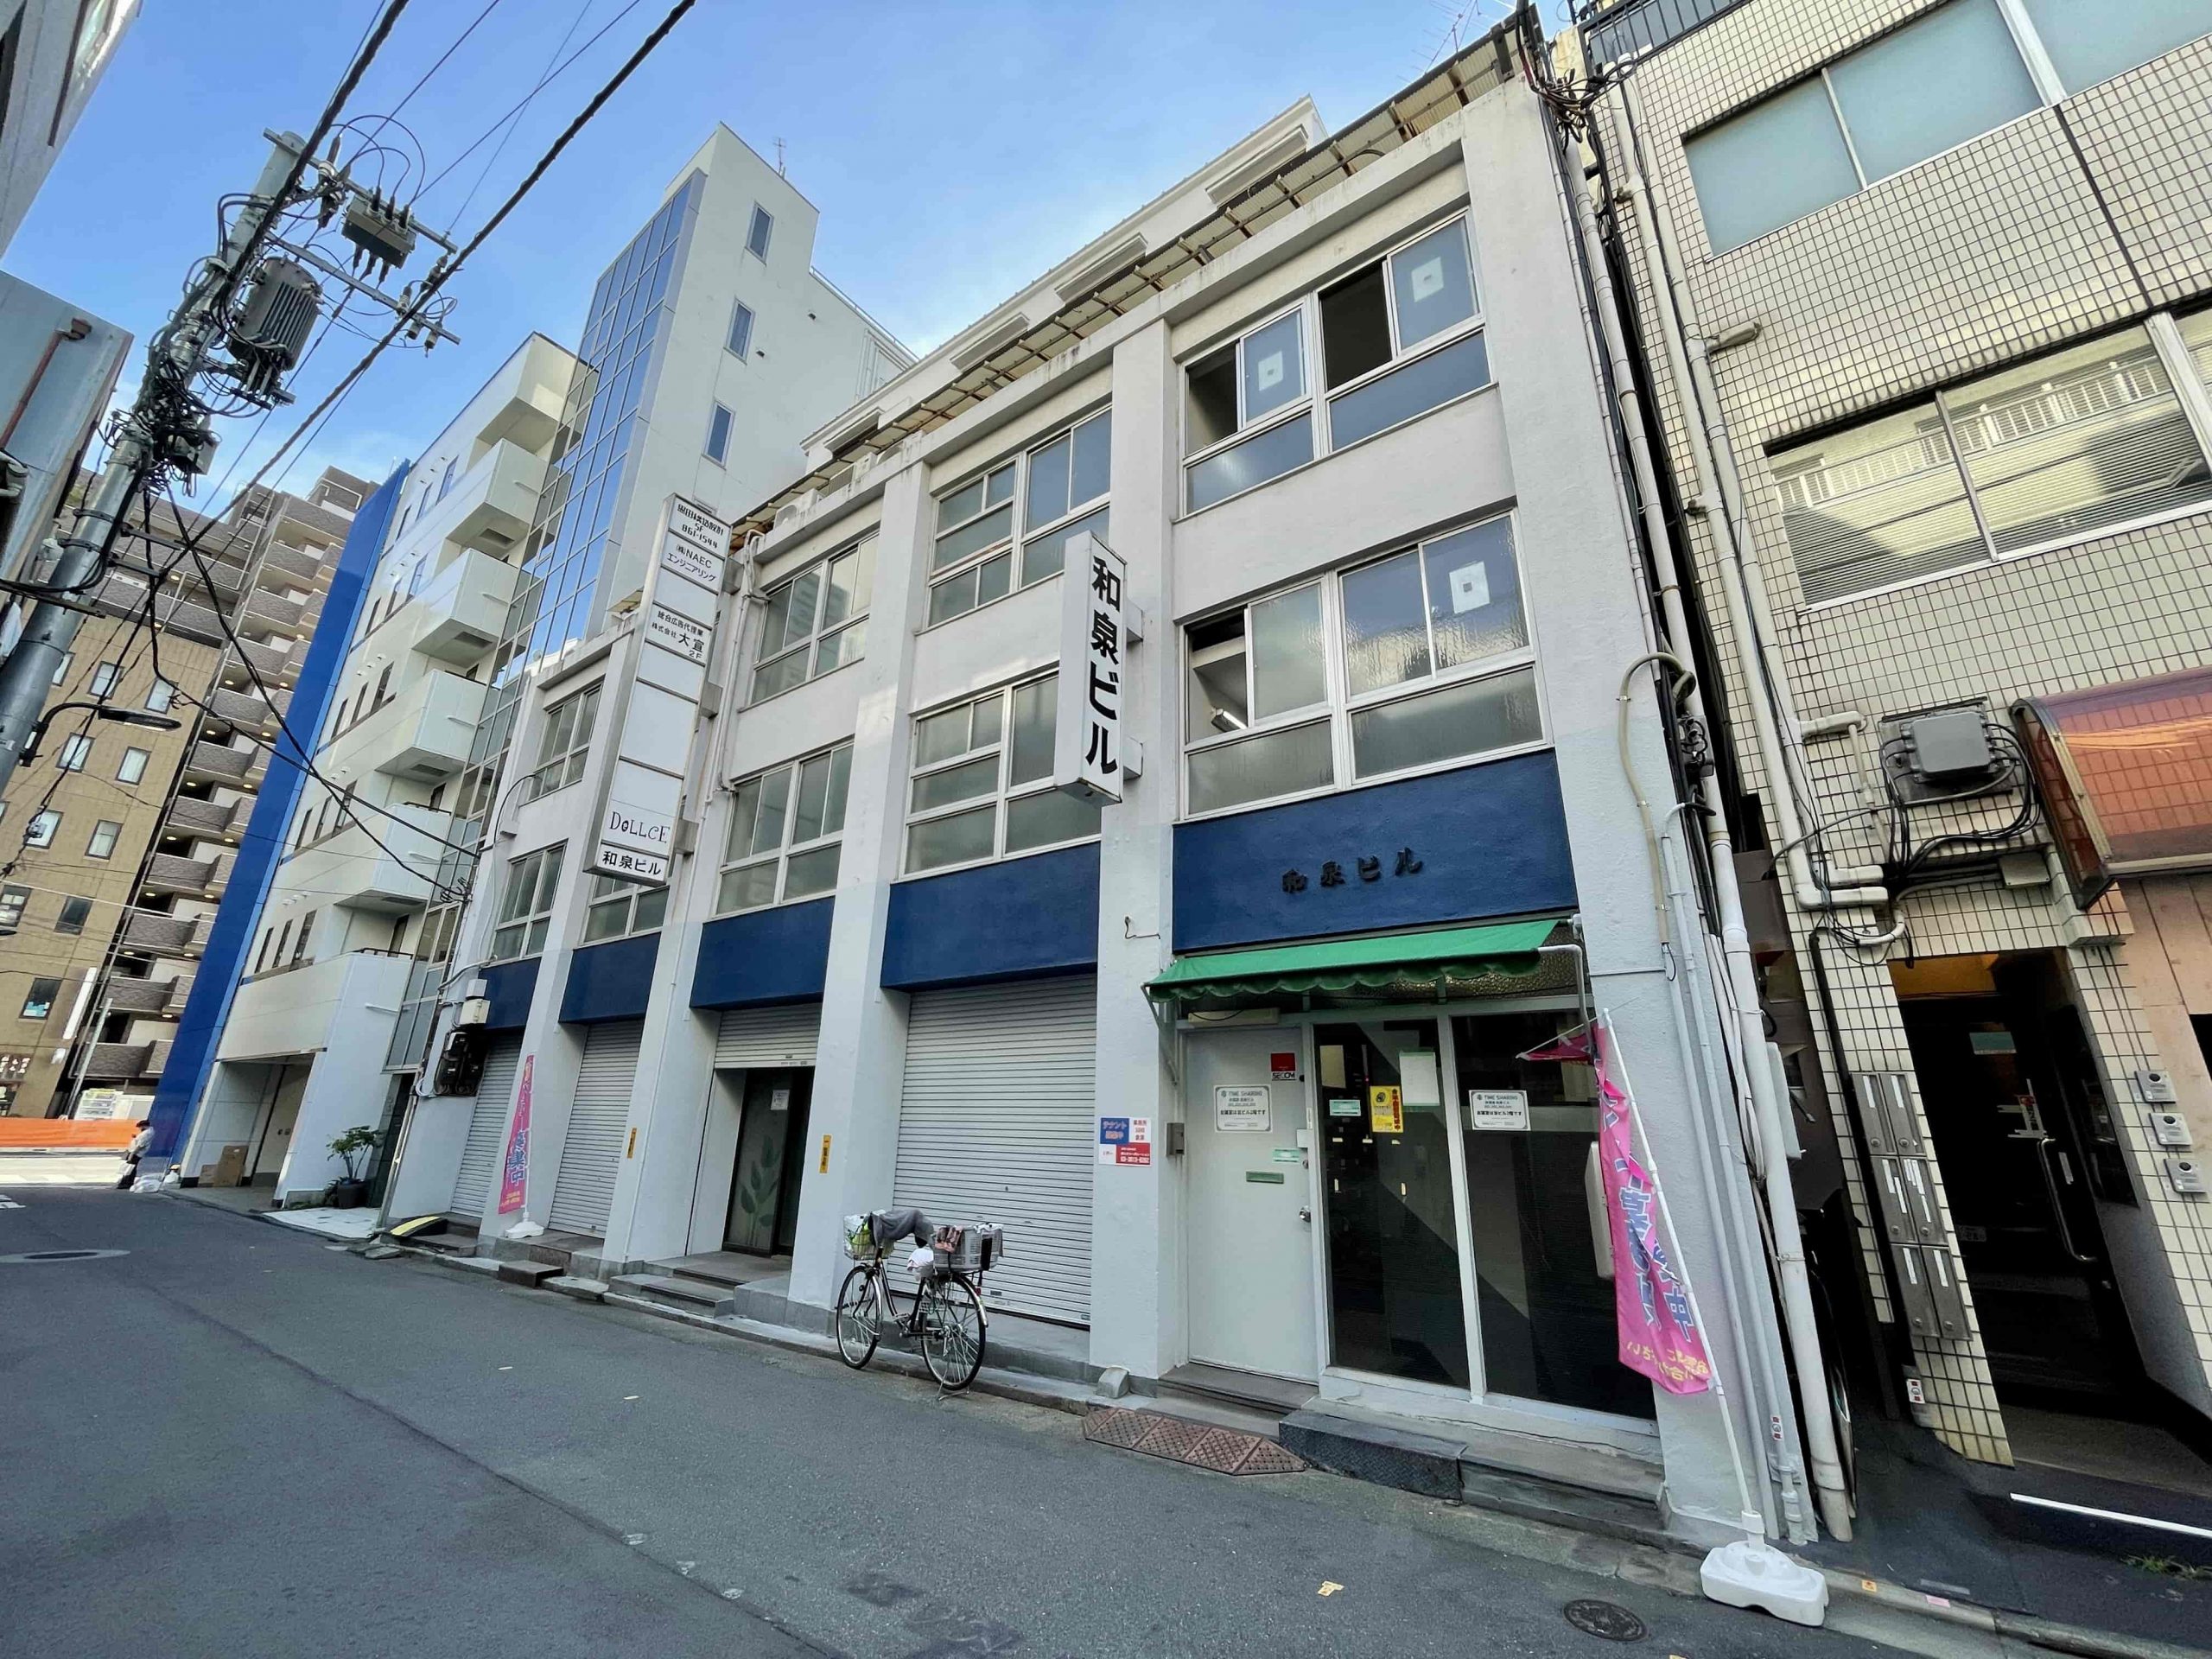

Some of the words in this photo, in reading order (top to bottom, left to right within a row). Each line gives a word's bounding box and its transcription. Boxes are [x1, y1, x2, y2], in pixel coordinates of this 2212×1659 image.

[667, 553, 716, 582] エンジニアリング
[689, 650, 702, 659] 2F
[1085, 556, 1121, 774] 和泉ビル
[602, 850, 662, 875] 和泉ビル
